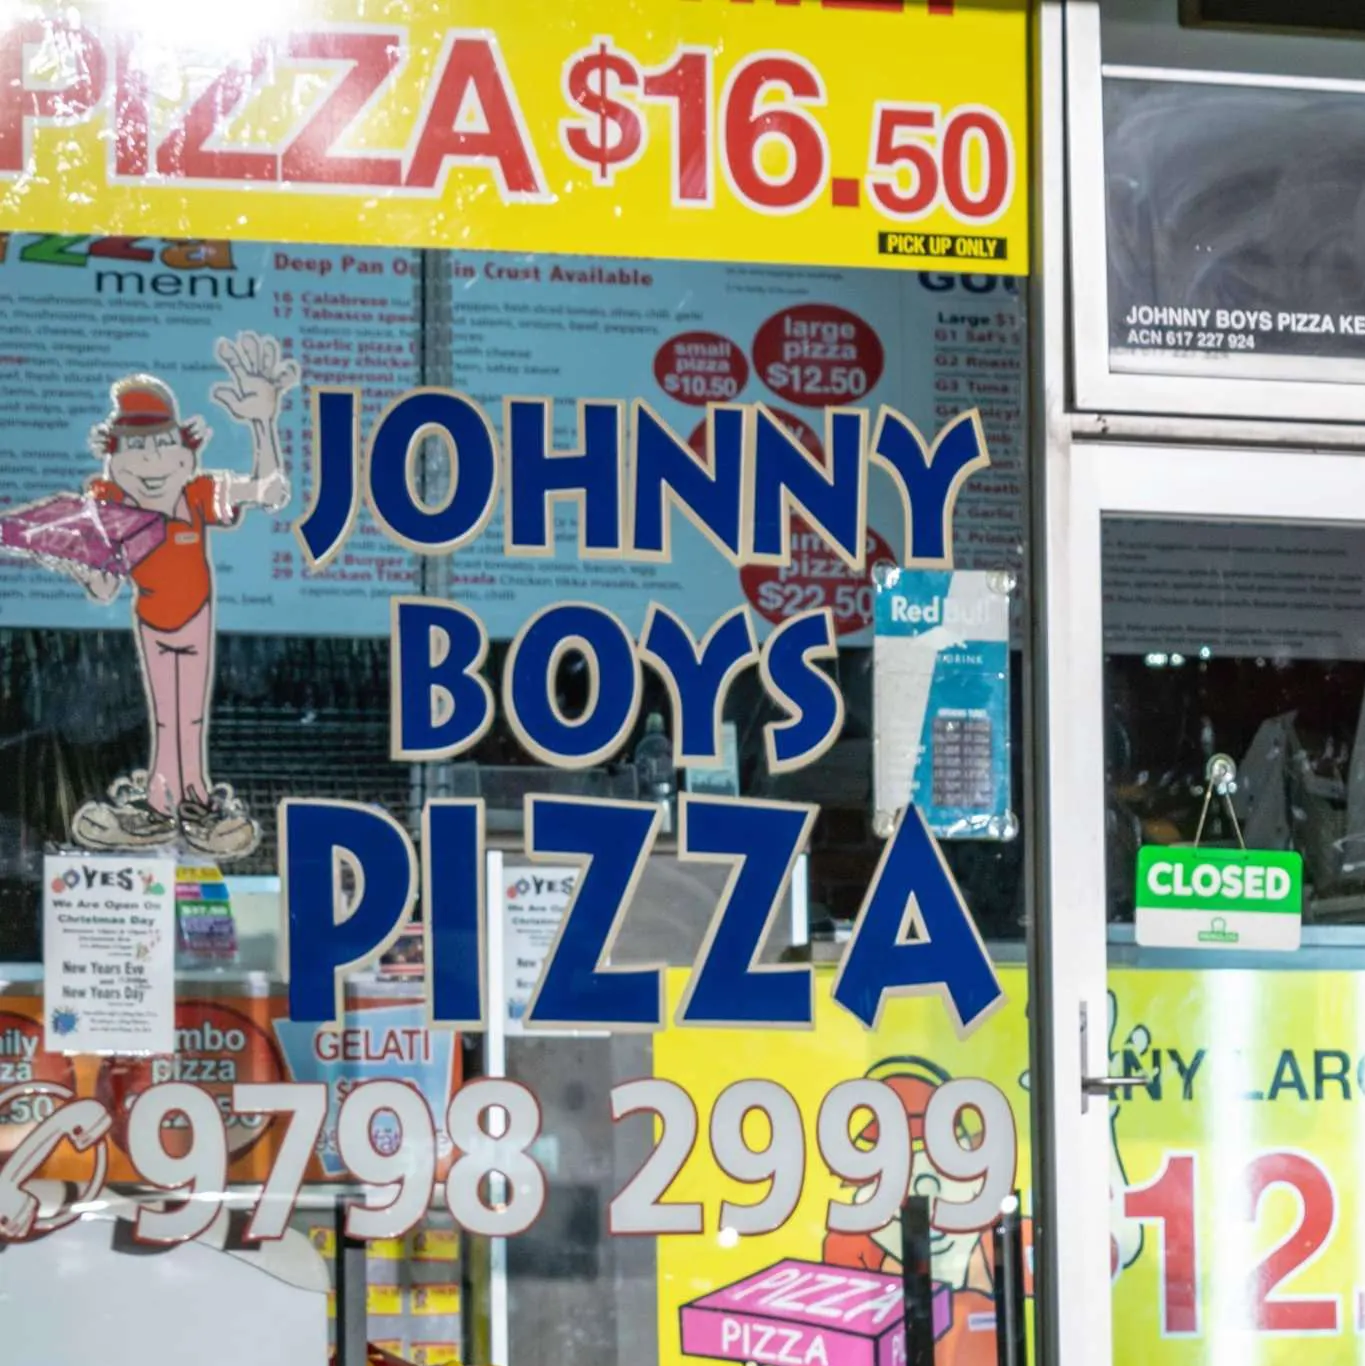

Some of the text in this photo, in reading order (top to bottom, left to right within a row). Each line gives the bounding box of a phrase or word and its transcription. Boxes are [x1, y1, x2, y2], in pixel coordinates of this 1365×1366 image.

[0, 26, 1013, 221] PIZZA $16.50
[887, 235, 997, 257] PICK UP ONLY
[274, 253, 654, 287] Deep Pan Crust Available
[96, 270, 257, 299] menu
[301, 292, 388, 307] Calabrese
[302, 307, 373, 322] Tabasco
[938, 311, 990, 327] Large
[1126, 304, 1210, 328] JOHNNY
[1215, 308, 1274, 331] BOYS
[1277, 311, 1335, 335] PIZZA
[784, 315, 856, 342] large
[1127, 330, 1255, 349] ACN 617 227 924
[302, 337, 352, 351] Garlic
[673, 341, 730, 358] small
[783, 339, 857, 361] pizza
[302, 353, 350, 369] Satay
[677, 357, 730, 373] pizza
[302, 368, 394, 384] Pepperoni
[664, 375, 737, 397] $10.50
[767, 364, 867, 395] $12.50
[295, 386, 991, 568] JOHNNY
[344, 554, 404, 568] Burger
[891, 595, 939, 624] Red
[390, 595, 845, 774] BOYS
[1148, 860, 1292, 900] CLOSED
[52, 899, 72, 909] We
[77, 900, 99, 910] Are
[104, 900, 139, 911] Open
[278, 791, 1010, 1041] PIZZA
[57, 913, 155, 927] Christmas Day
[62, 961, 145, 975] New Years Eve
[62, 986, 145, 1003] New Years Day
[174, 1021, 246, 1051] mbo
[314, 1028, 431, 1062] GELATI
[152, 1053, 237, 1083] pizza
[128, 1078, 548, 1245] 9798
[608, 1077, 1018, 1237] 2999
[732, 1265, 905, 1323] PIZZA
